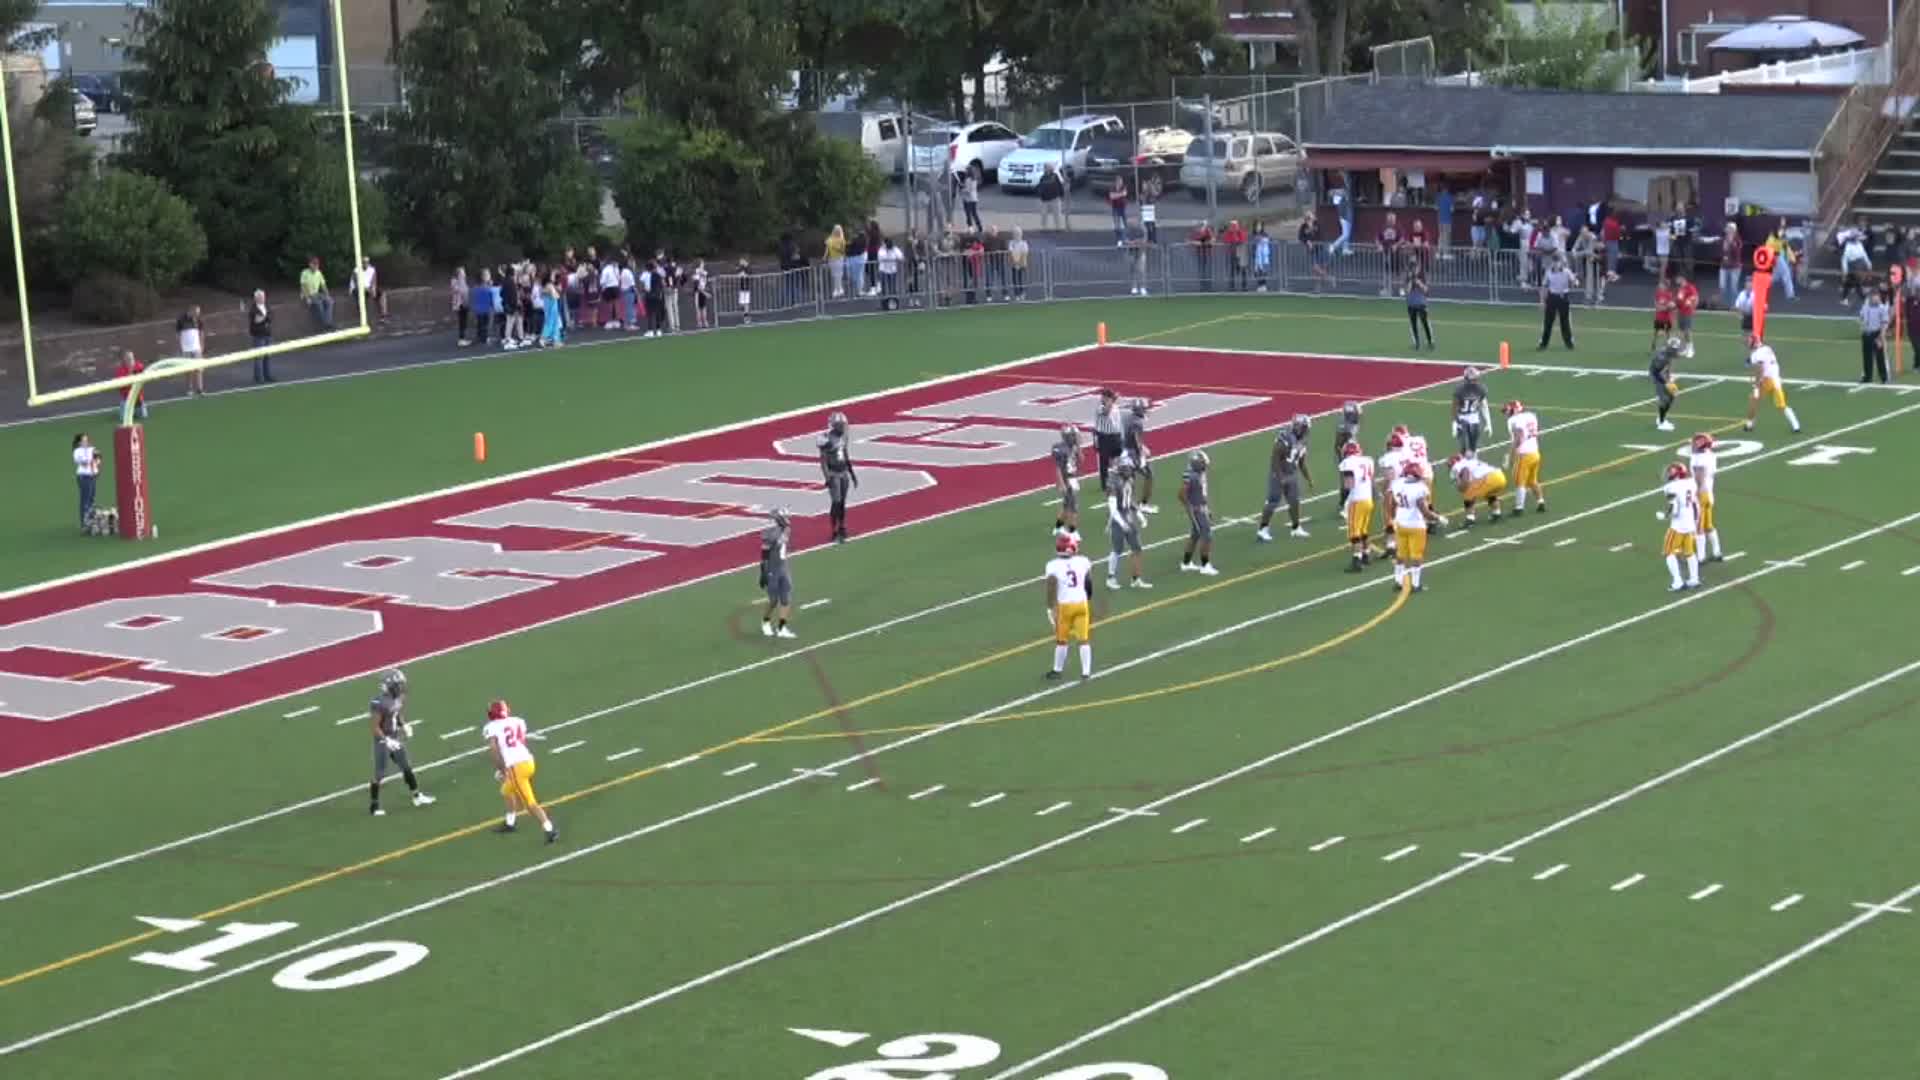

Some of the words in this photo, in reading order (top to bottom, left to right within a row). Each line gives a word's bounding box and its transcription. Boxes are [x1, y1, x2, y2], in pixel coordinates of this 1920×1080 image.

[1066, 570, 1078, 588] 3
[503, 724, 528, 748] 24
[129, 920, 430, 991] 10
